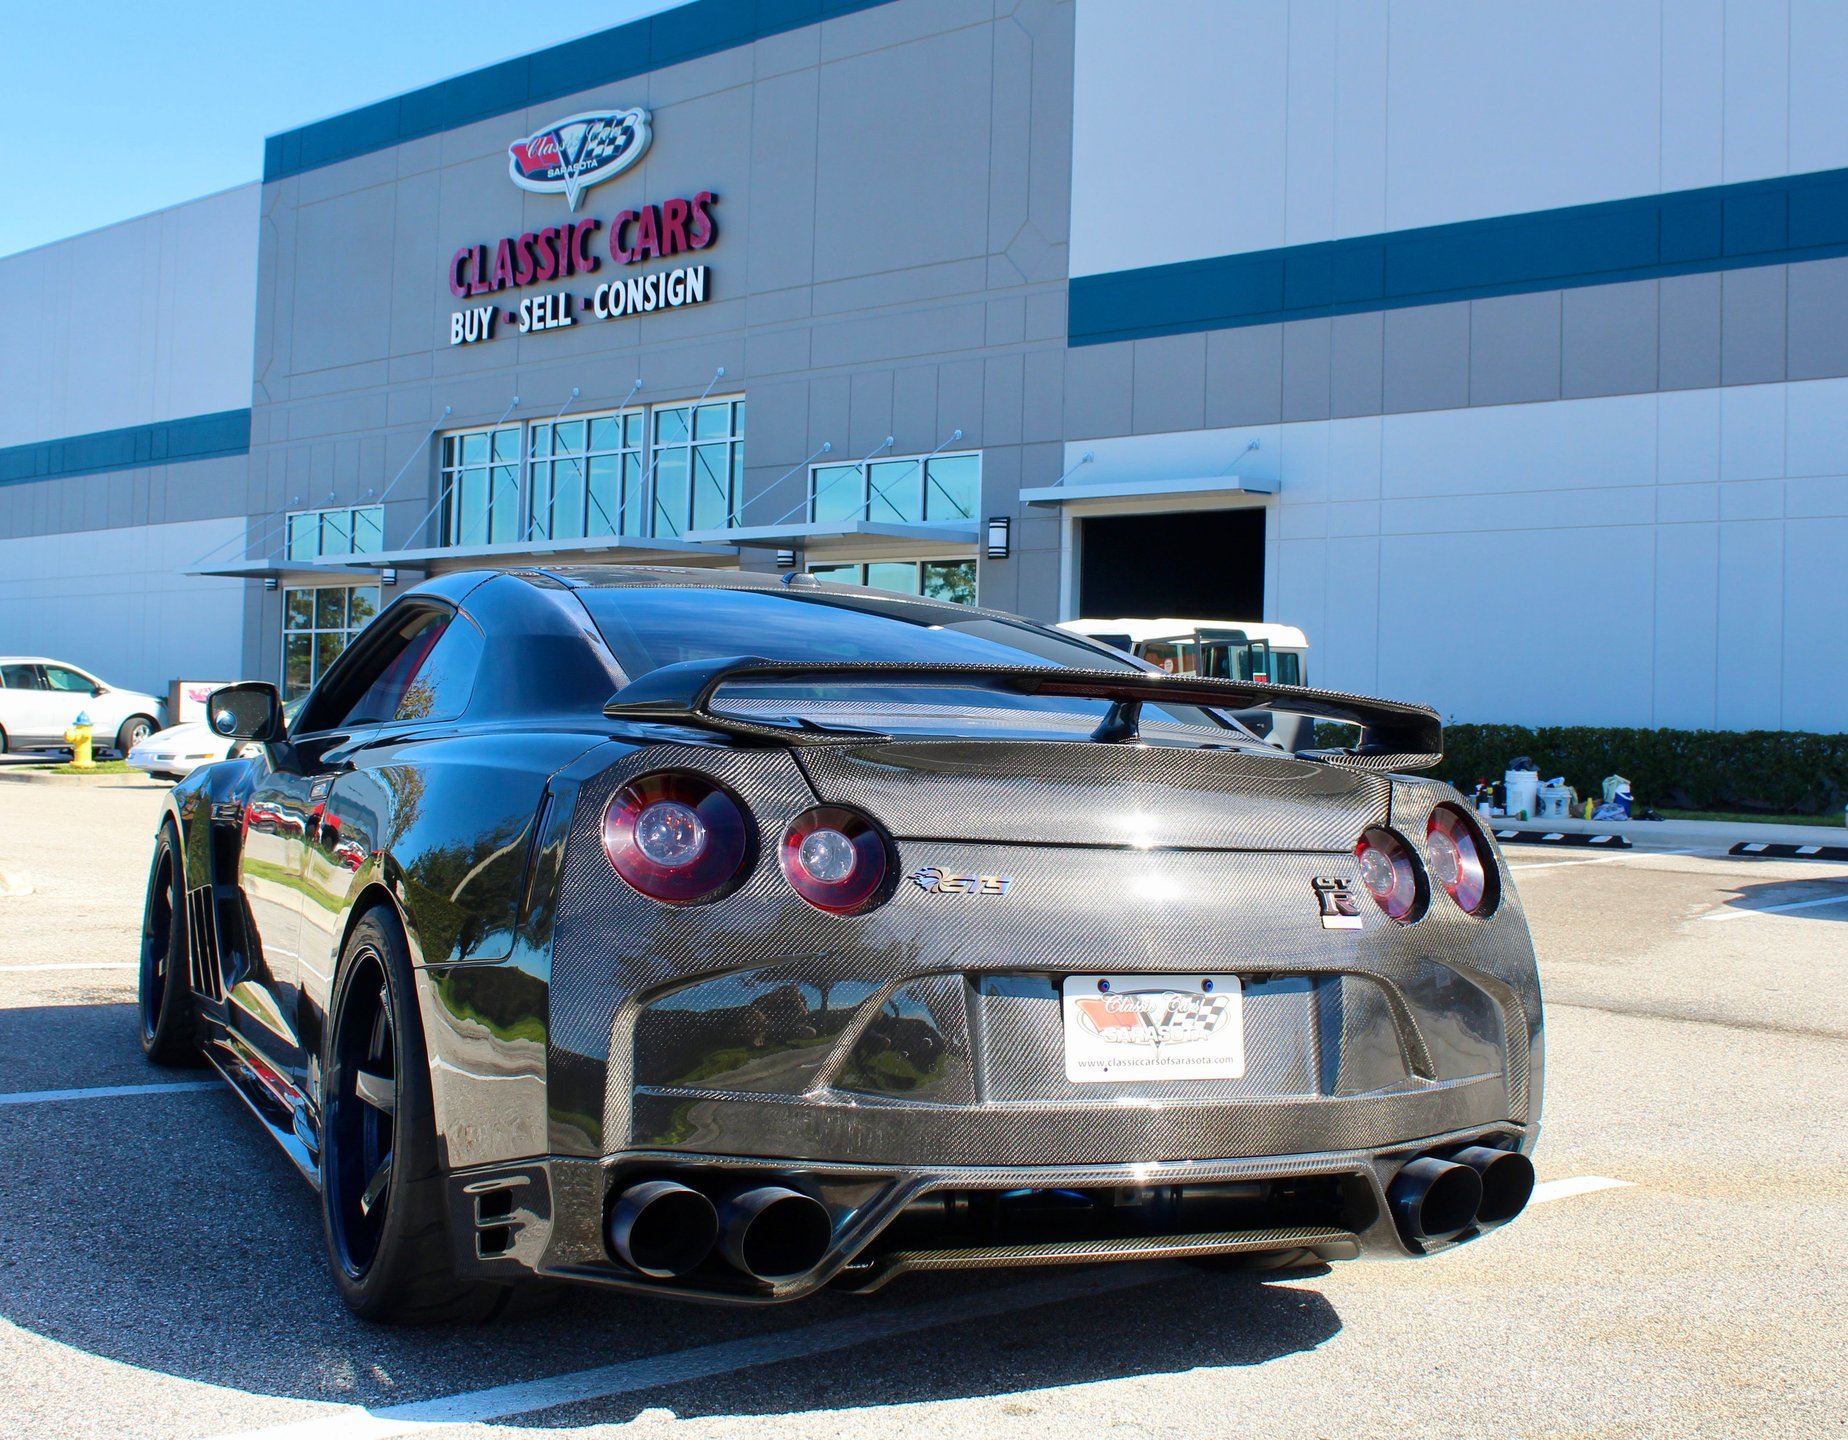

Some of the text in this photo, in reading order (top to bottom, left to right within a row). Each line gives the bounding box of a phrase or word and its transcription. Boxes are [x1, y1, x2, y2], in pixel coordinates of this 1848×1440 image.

[547, 159, 598, 178] SARASOTA
[450, 191, 714, 298] CLASSIC CARS
[451, 265, 705, 345] BUY SELL CONSIGN
[1103, 1025, 1209, 1044] SARASOTA
[1077, 1056, 1235, 1068] www.classiccarsofsarasota.com
